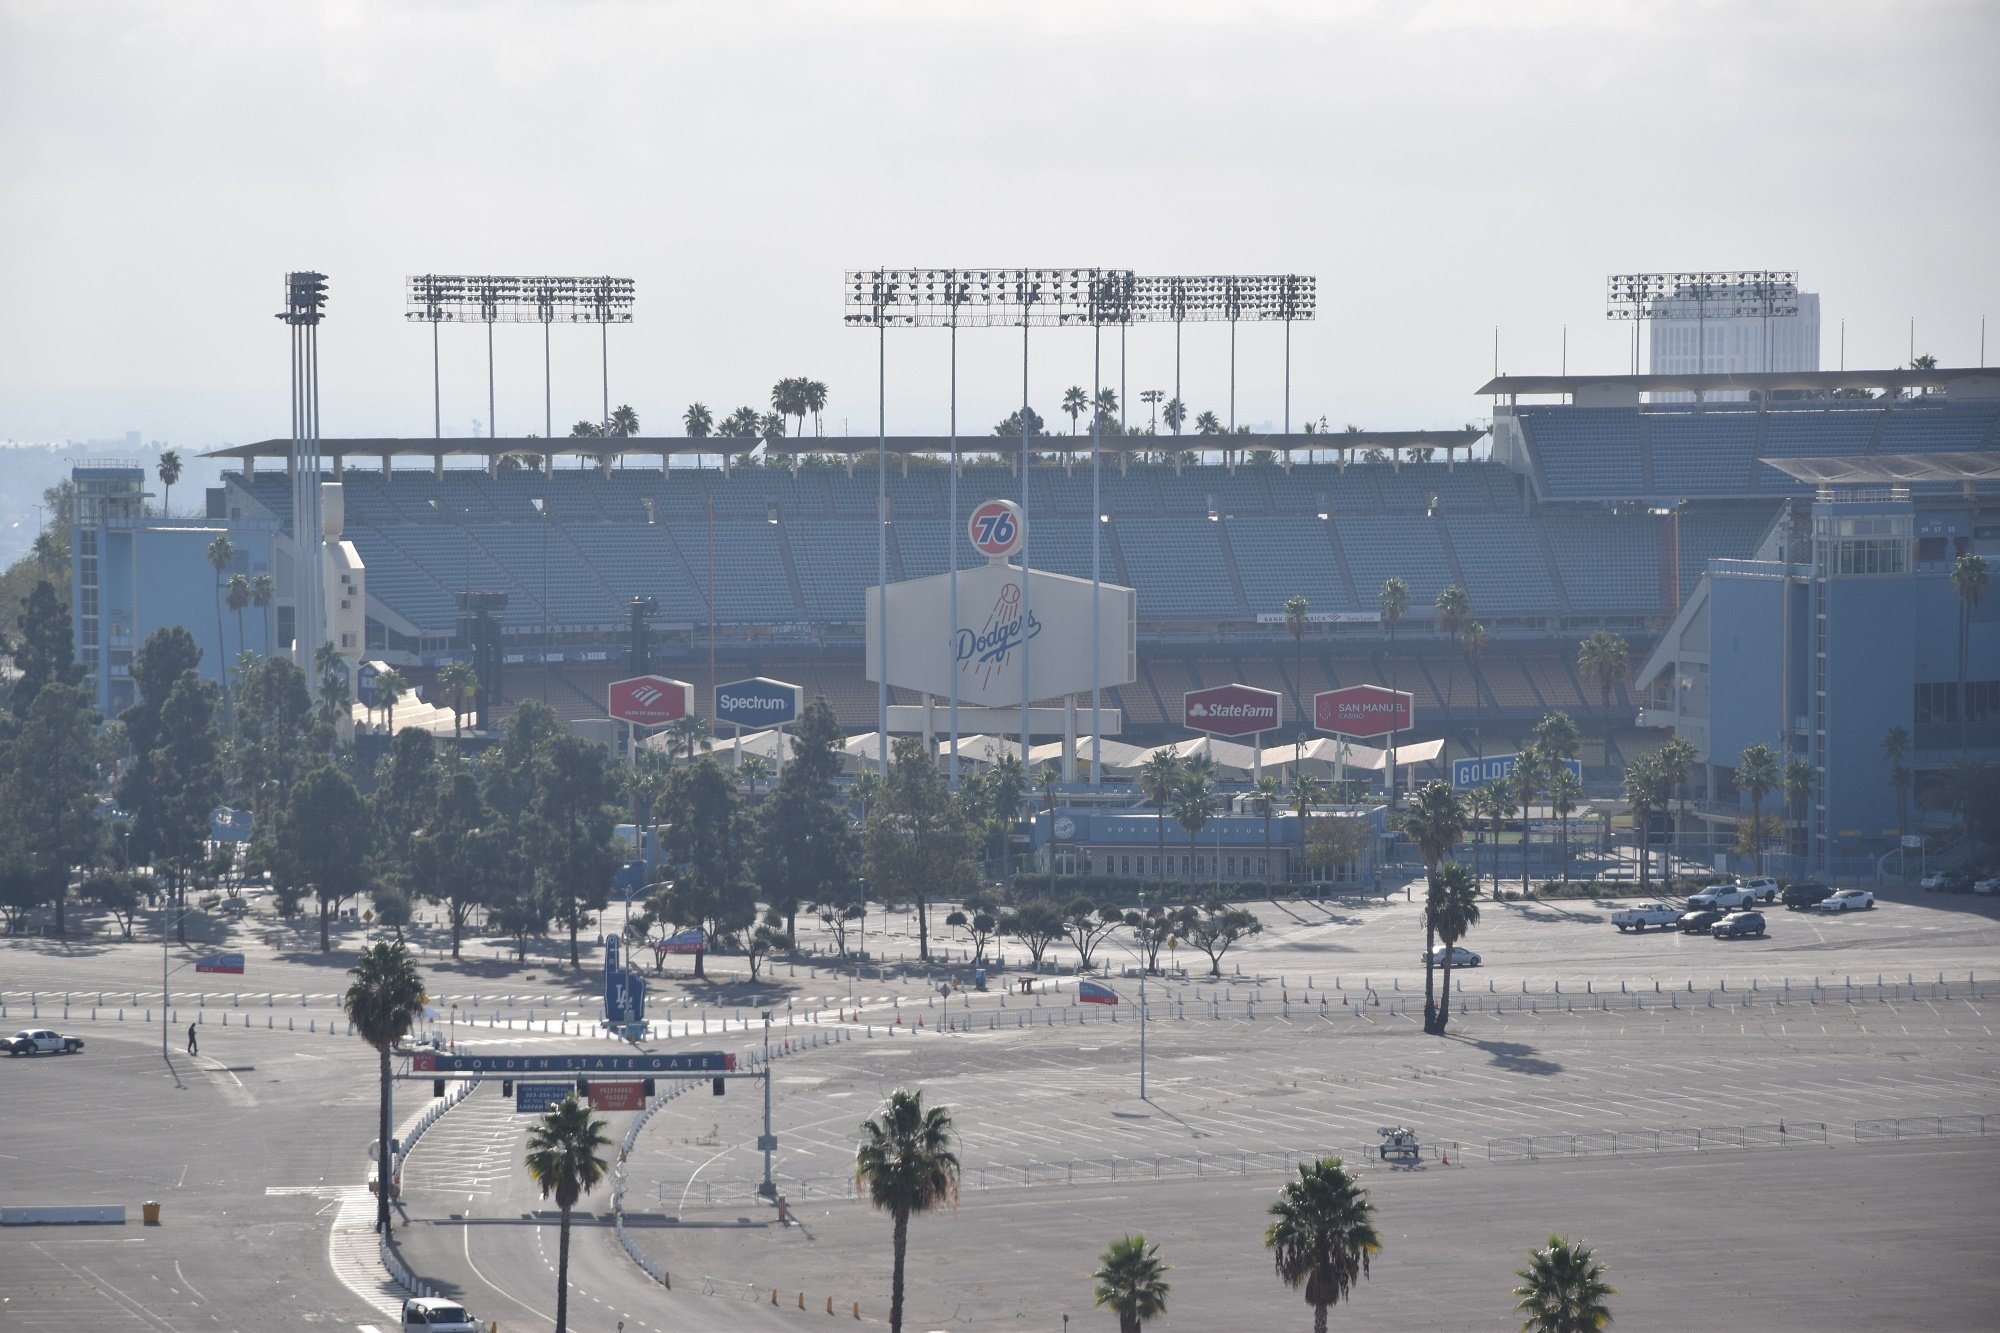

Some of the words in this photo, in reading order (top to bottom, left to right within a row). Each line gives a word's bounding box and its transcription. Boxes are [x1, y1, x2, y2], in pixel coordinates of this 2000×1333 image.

[976, 512, 1014, 545] 76
[720, 694, 785, 712] Spectrum
[1338, 703, 1361, 712] SAN
[1362, 704, 1406, 712] MANUEL
[616, 984, 632, 1009] LA
[420, 1060, 428, 1070] C
[454, 1058, 548, 1069] GOLDEN
[566, 1058, 635, 1068] STATE
[652, 1058, 710, 1068] GATE
